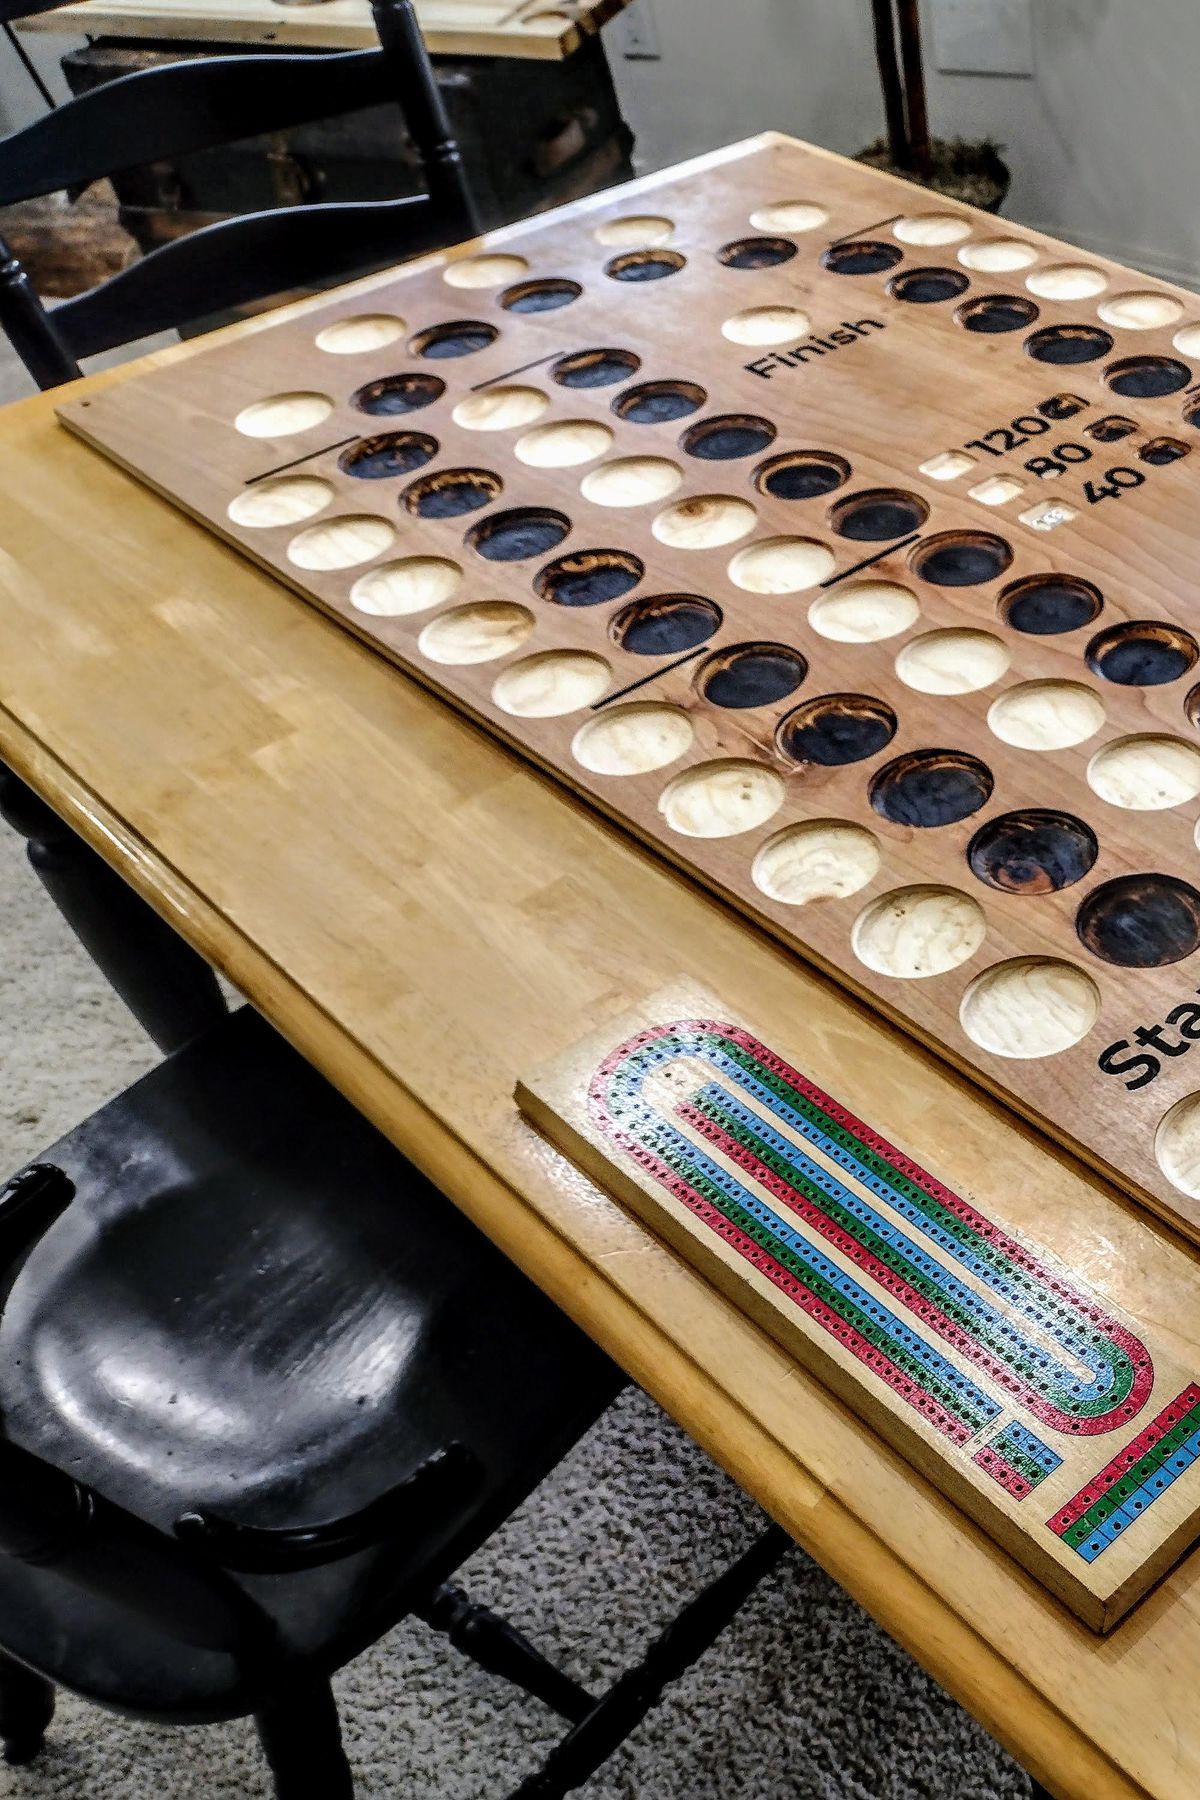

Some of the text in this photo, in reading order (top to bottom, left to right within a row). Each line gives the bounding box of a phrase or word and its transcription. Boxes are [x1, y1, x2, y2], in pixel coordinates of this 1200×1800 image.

[743, 318, 887, 379] Finish
[964, 416, 1051, 456] 120
[1024, 443, 1092, 479] 80
[1083, 467, 1146, 504] 40
